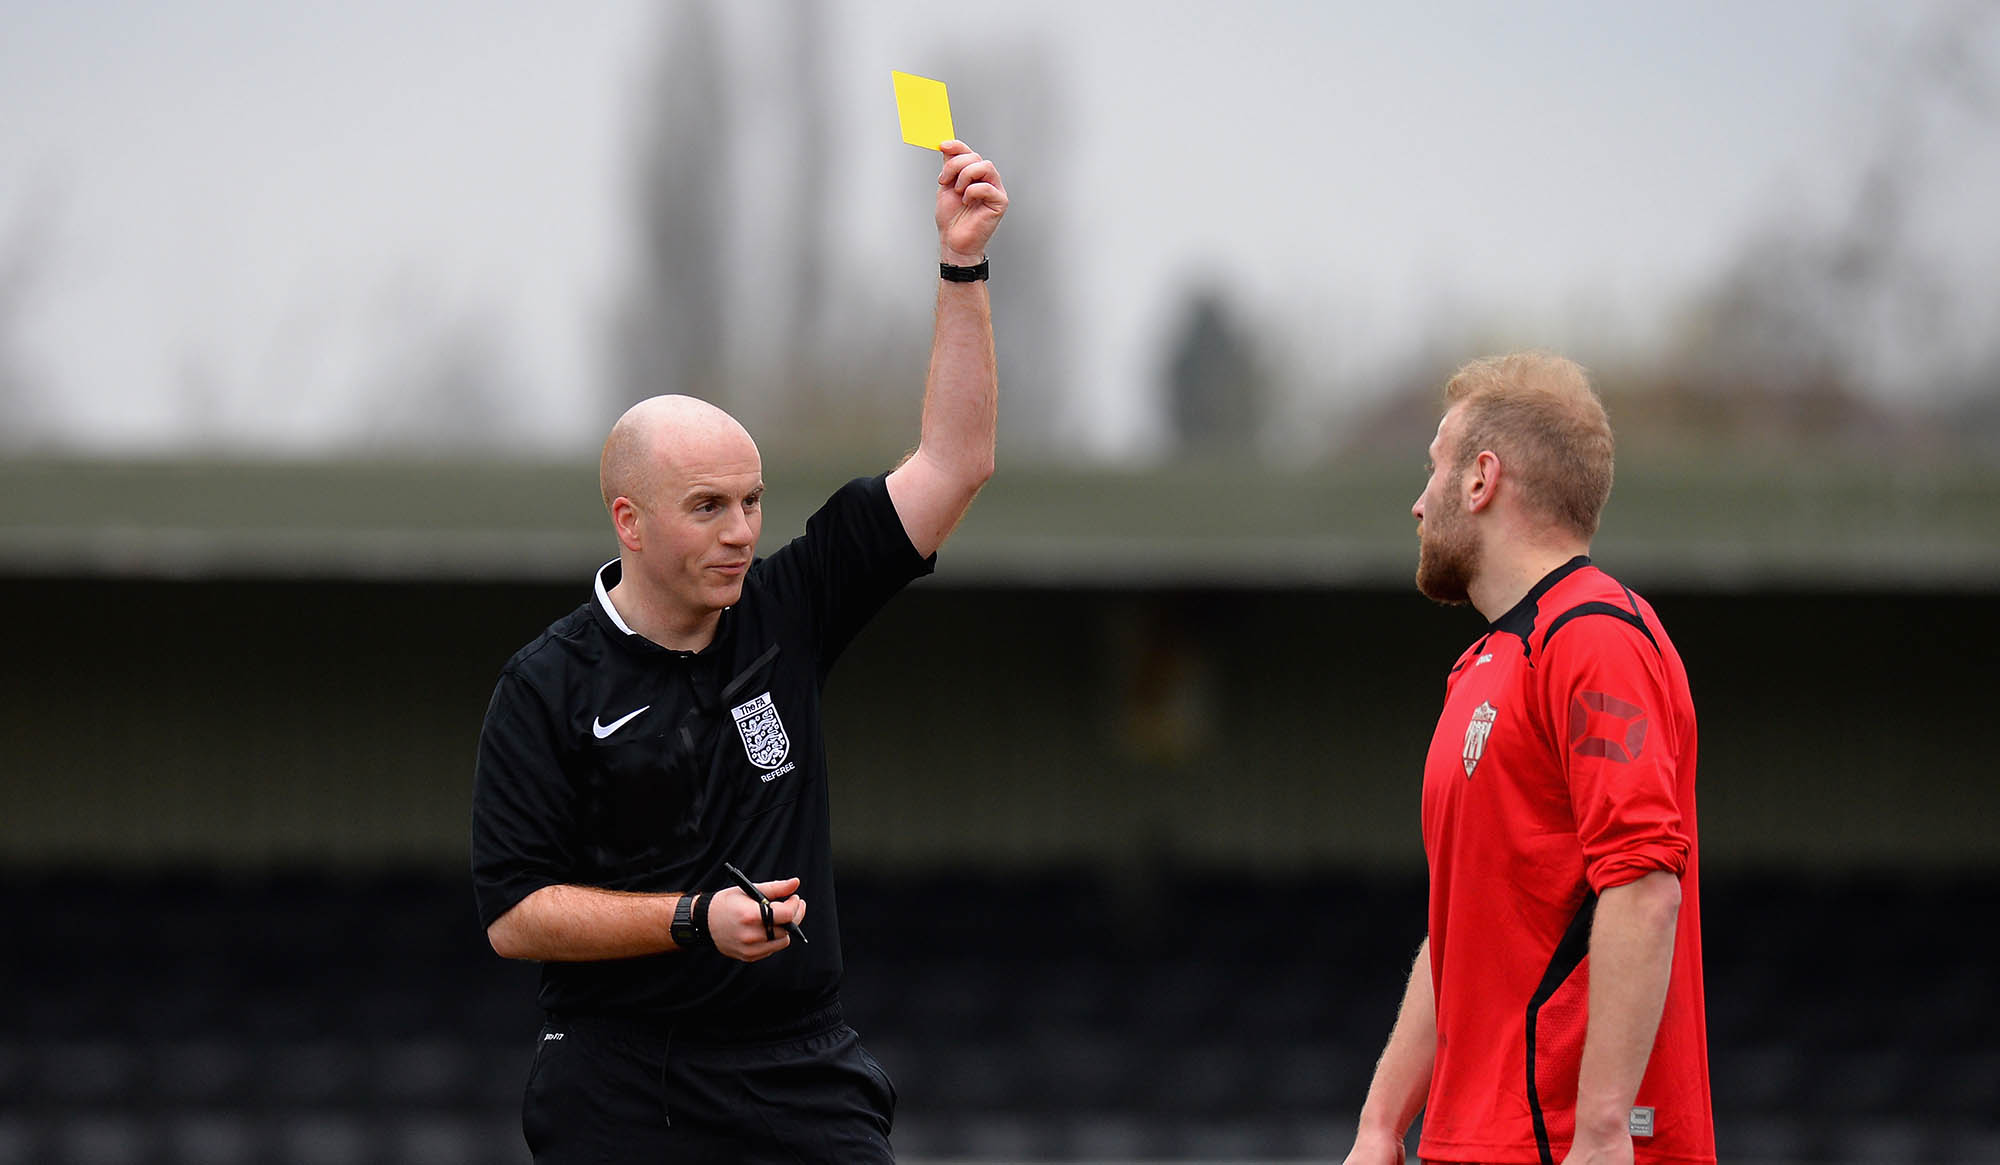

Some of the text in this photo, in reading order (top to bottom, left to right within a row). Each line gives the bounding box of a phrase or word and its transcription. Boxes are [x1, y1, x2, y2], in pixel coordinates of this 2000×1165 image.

[739, 697, 766, 715] The FA
[760, 761, 796, 783] REFEREE
